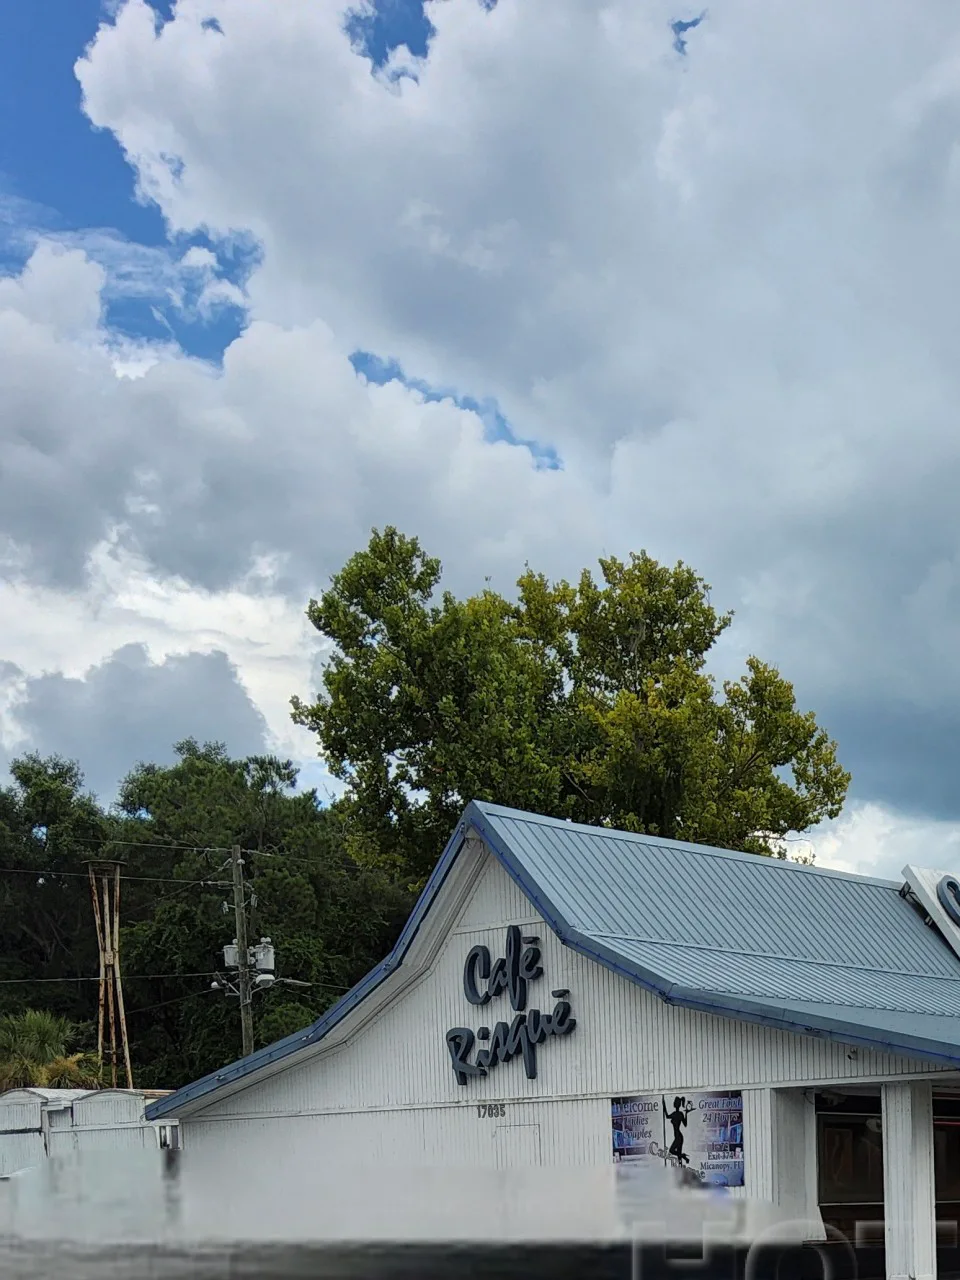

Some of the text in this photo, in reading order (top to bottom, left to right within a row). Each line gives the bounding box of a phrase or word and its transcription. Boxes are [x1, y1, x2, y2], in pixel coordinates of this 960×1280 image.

[699, 1099, 719, 1109] Great
[702, 1113, 712, 1122] 24
[623, 1129, 652, 1140] Couples
